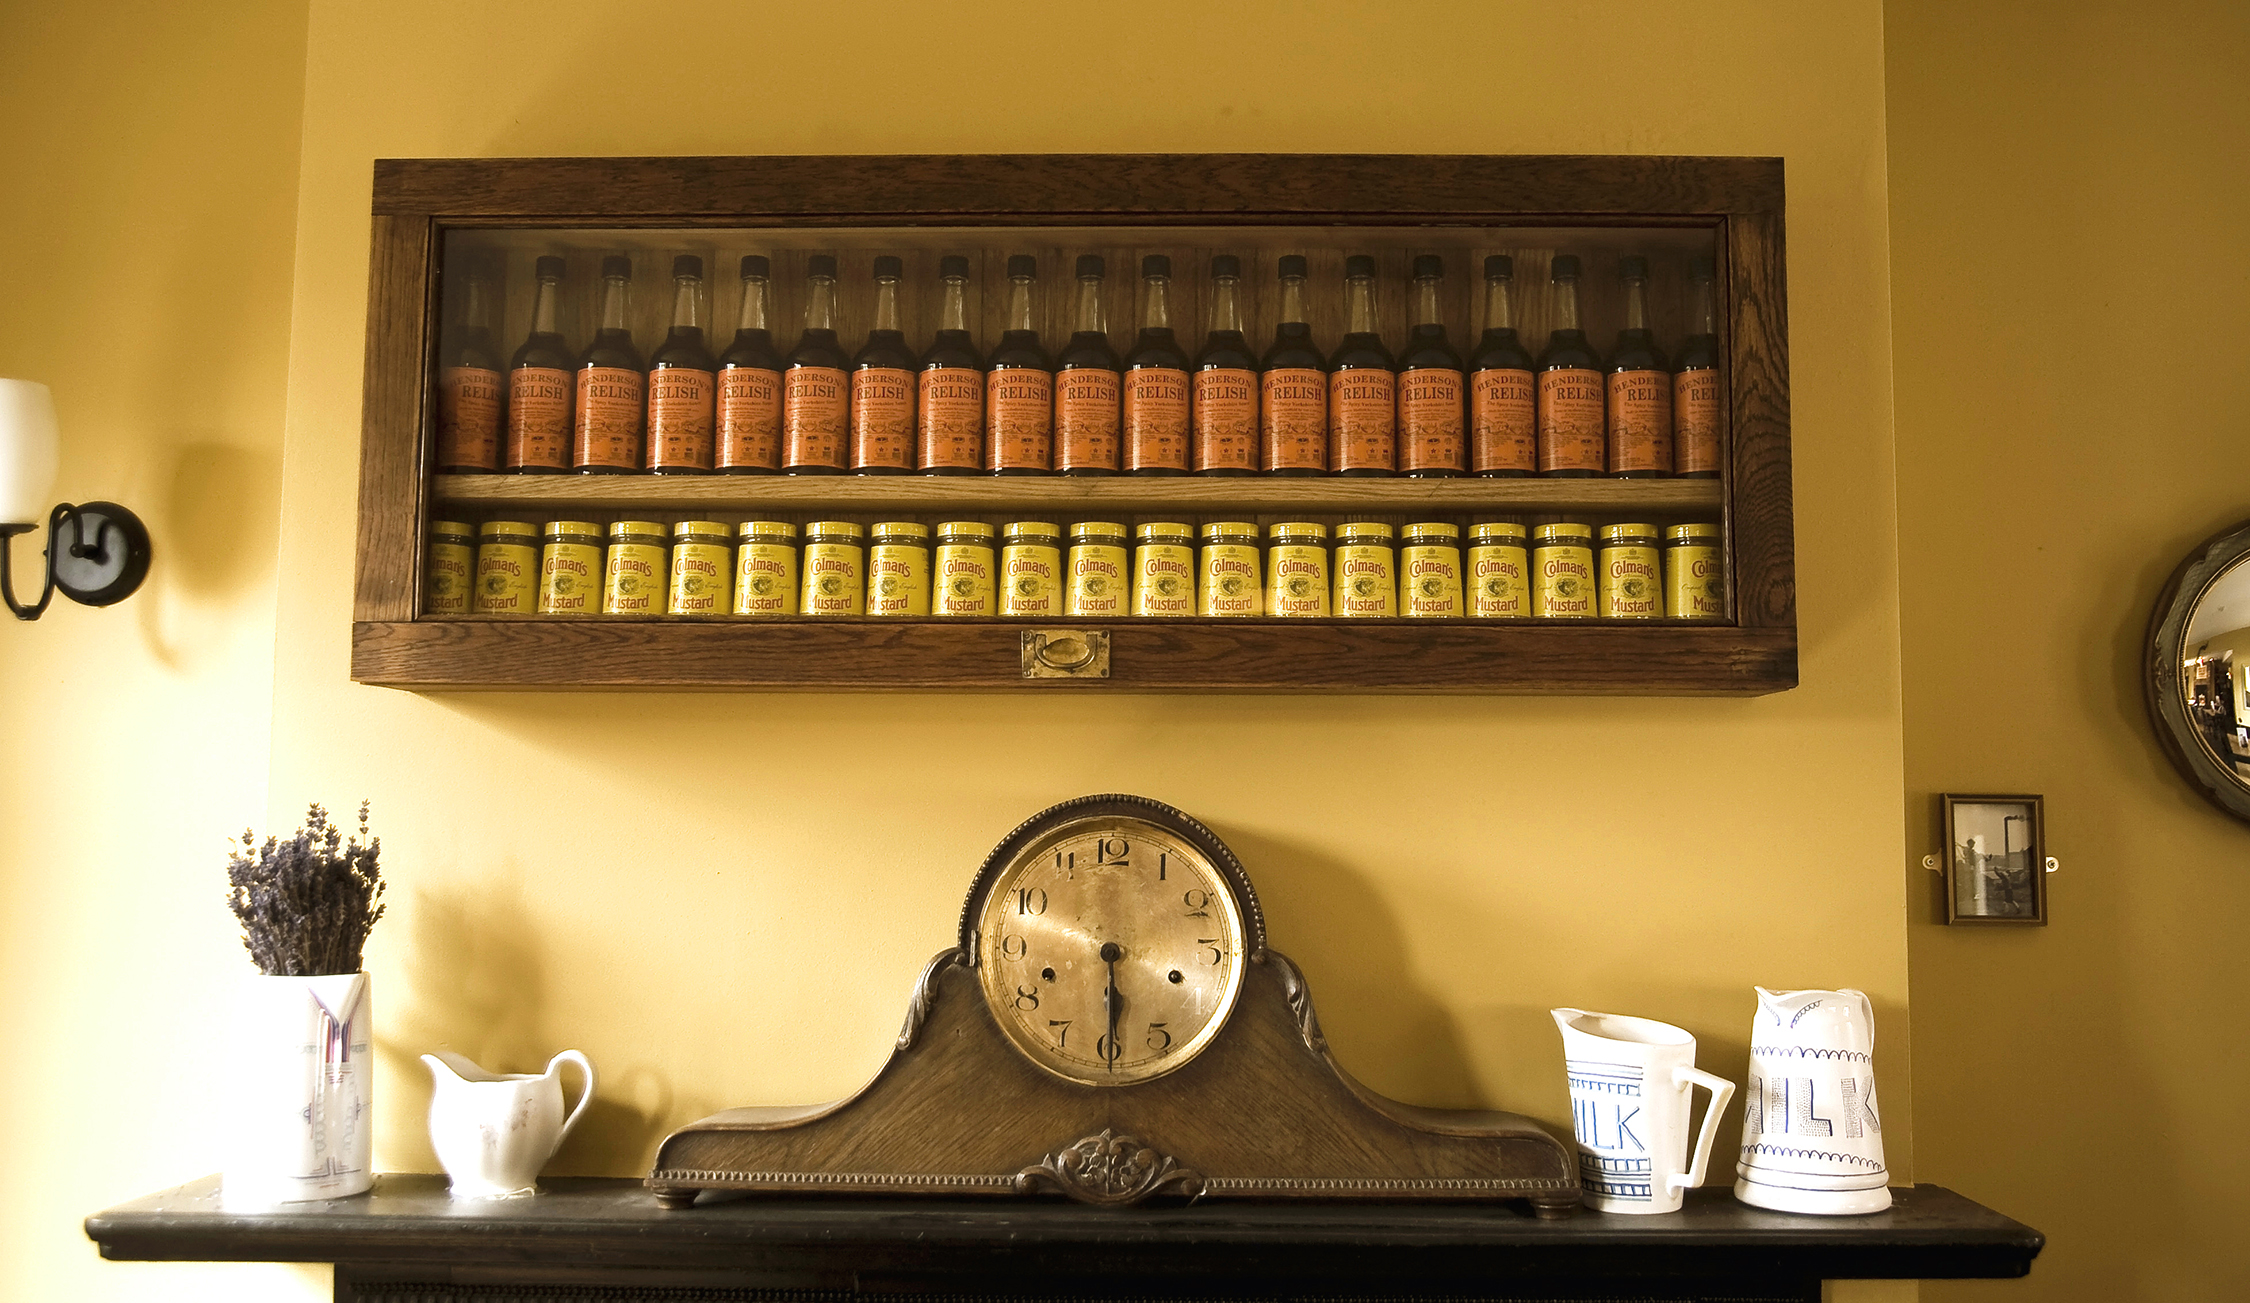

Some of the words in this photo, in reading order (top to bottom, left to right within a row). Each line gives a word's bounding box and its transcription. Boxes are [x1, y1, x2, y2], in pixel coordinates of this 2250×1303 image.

[514, 386, 563, 400] RELISH
[589, 386, 638, 401] RELISH
[652, 386, 699, 400] RELISH
[789, 385, 836, 399] RELISH
[857, 386, 904, 400] RELISH
[931, 386, 978, 401] RELISH
[1000, 386, 1047, 401] RELISH
[1068, 386, 1115, 401] RELISH
[1137, 386, 1184, 401] RELISH
[1200, 386, 1247, 401] RELISH
[1274, 386, 1321, 401] RELISH
[1343, 386, 1390, 401] RELISH
[1405, 386, 1453, 401] RELISH
[1556, 387, 1602, 402] RELISH
[480, 557, 521, 577] Colman's
[545, 557, 588, 577] Colman's
[611, 557, 653, 577] Colman's
[675, 558, 717, 577] Colman's
[743, 558, 785, 577] Colman's
[811, 558, 854, 577] Colman's
[943, 558, 986, 579] Colman's
[1007, 559, 1050, 578] Colman's
[1075, 559, 1118, 578] Colman's
[1145, 558, 1188, 578] Colman's
[1210, 558, 1253, 578] Colman's
[1277, 559, 1320, 579] Colman's
[1343, 559, 1386, 579] Colman's
[1409, 560, 1453, 579] Colman's
[1475, 560, 1519, 579] Colman's
[1544, 560, 1588, 580] Colman's
[1610, 560, 1654, 580] Colman's
[543, 593, 585, 609] Mustard
[608, 593, 649, 609] Mustard
[672, 593, 714, 609] Mustard
[1145, 594, 1188, 610] Mustard
[1210, 595, 1252, 610] Mustard
[1277, 595, 1320, 611] Mustard
[1342, 595, 1385, 611] Mustard
[1410, 595, 1453, 611] Mustard
[1475, 595, 1519, 611] Mustard
[1545, 595, 1588, 612] Mustard
[1611, 596, 1655, 612] Mustard
[1097, 838, 1129, 867] 12
[1159, 852, 1167, 881] 1
[1018, 886, 1048, 916] 10
[1183, 888, 1209, 918] 2
[1002, 934, 1027, 962] 9
[1196, 938, 1221, 967] 3
[1015, 983, 1039, 1012] 8
[1049, 1019, 1073, 1048] 7
[1146, 1022, 1171, 1050] 5
[1097, 1033, 1122, 1061] 6
